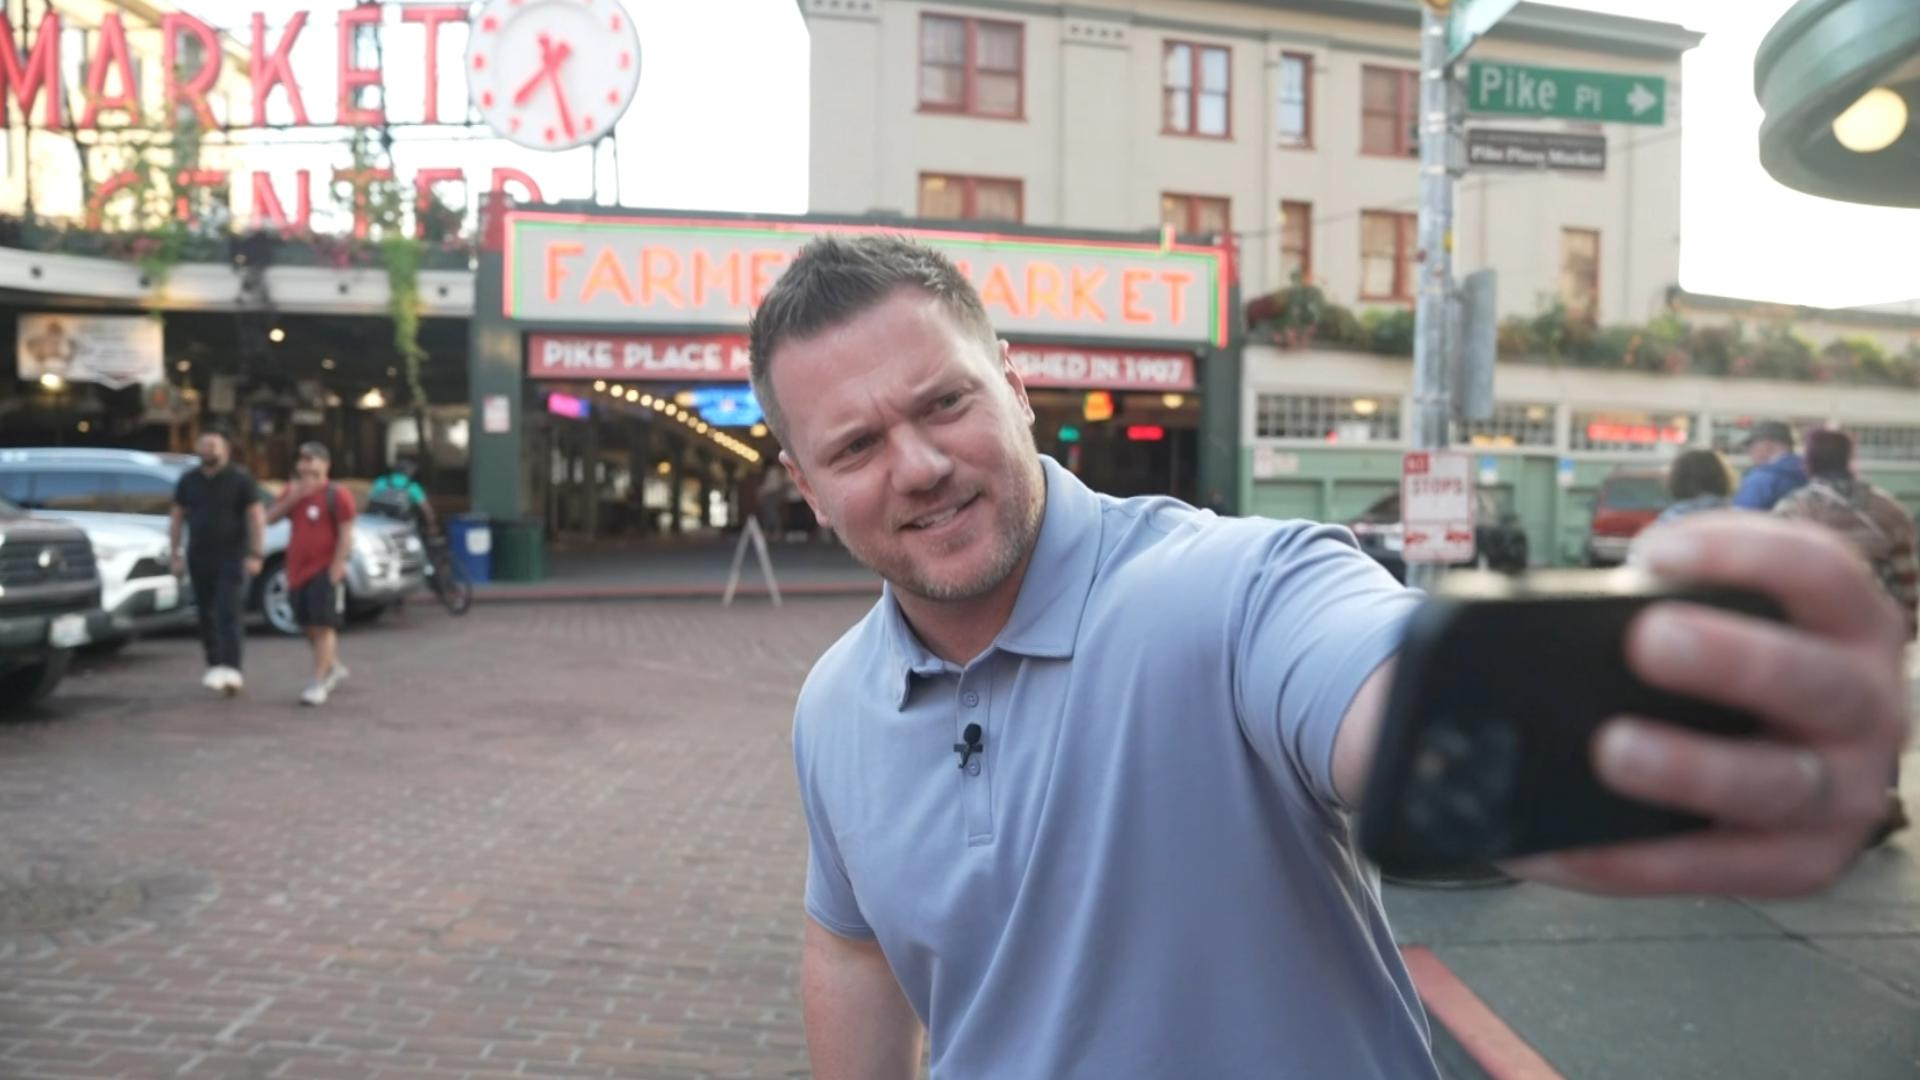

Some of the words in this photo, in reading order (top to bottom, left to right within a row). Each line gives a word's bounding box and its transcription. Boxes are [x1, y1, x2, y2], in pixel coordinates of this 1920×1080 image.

[0, 7, 470, 131] MARKET
[1479, 67, 1557, 111] Pike
[1575, 85, 1602, 113] Pl
[545, 241, 787, 309] FARME
[957, 259, 1194, 326] ARKET
[543, 339, 613, 370] PIKE
[623, 342, 722, 372] PLACE
[1090, 354, 1122, 381] IN
[1125, 356, 1184, 386] 1907
